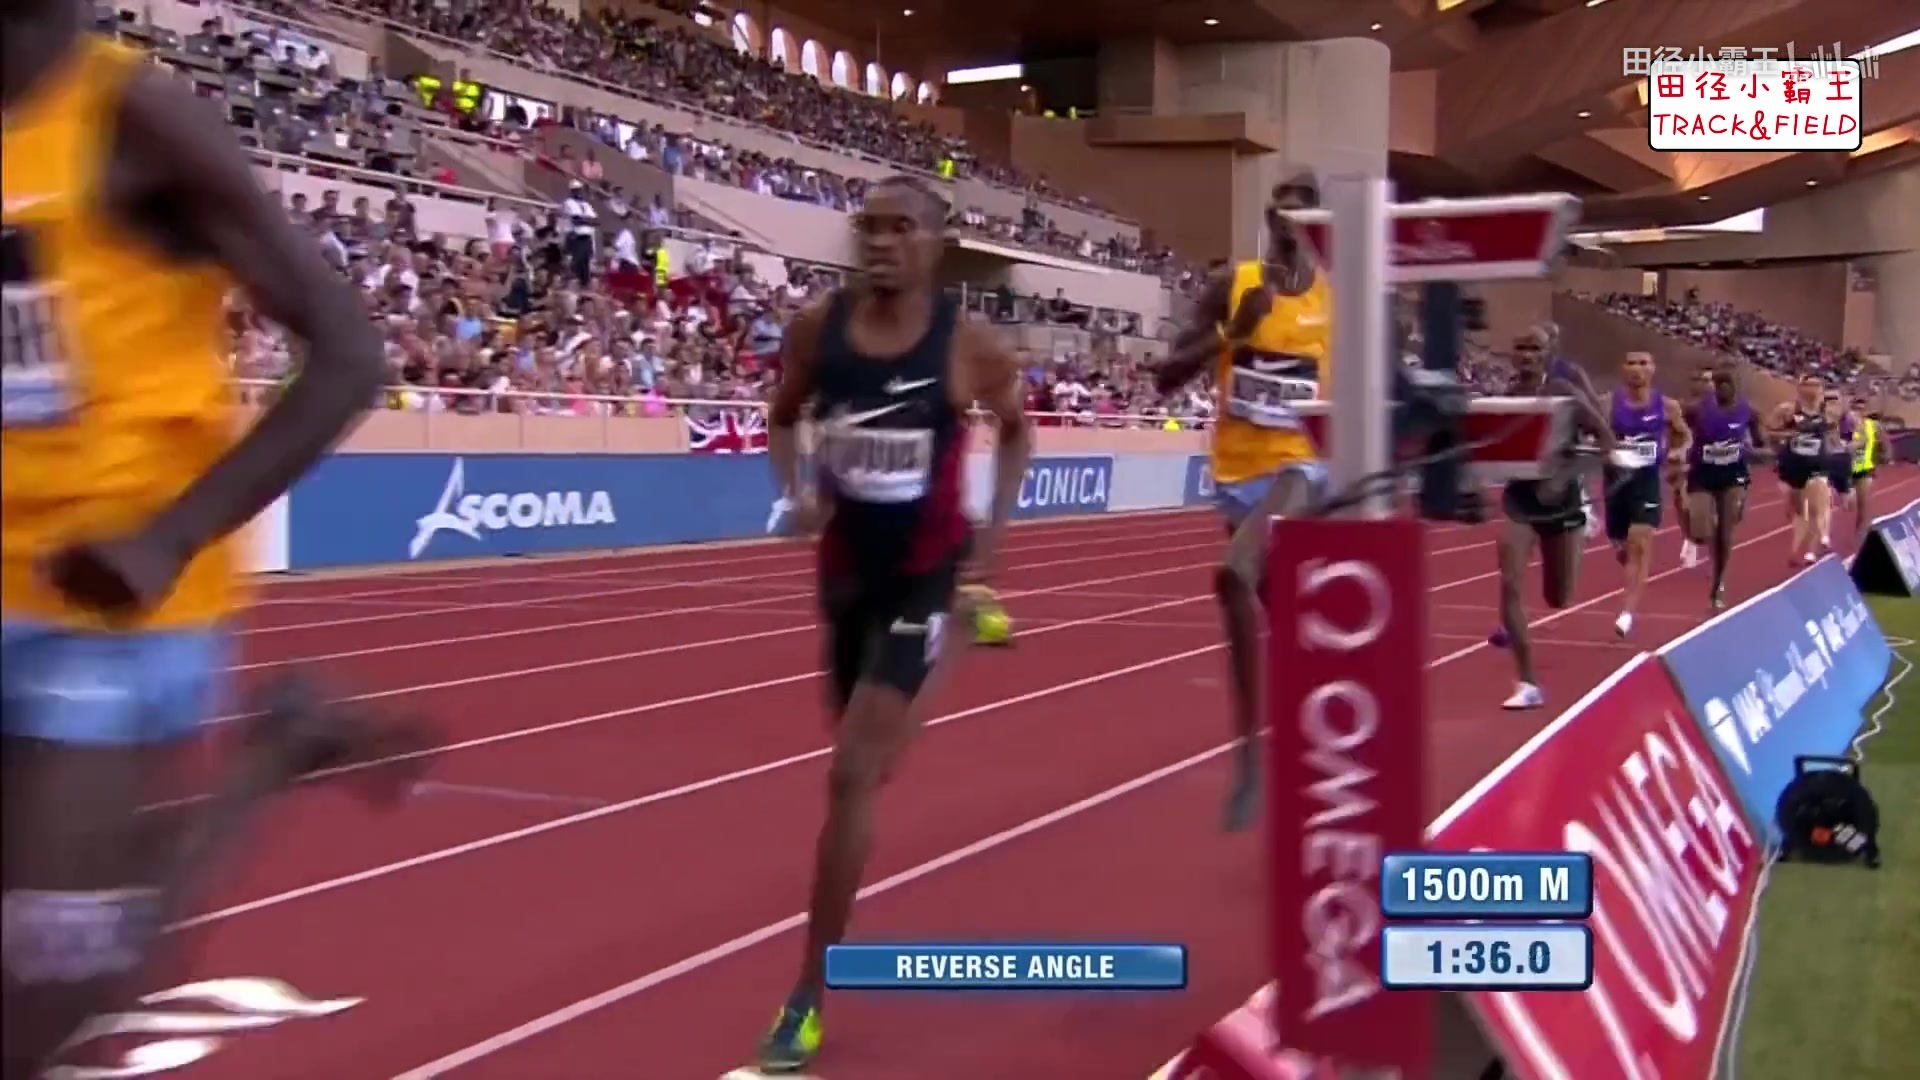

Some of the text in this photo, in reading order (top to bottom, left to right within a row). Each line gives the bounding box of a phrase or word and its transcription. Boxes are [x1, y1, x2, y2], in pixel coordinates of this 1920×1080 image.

[409, 456, 616, 560] ASCOMA
[1017, 466, 1105, 508] CONICA
[1301, 680, 1382, 1020] OMEGA
[1564, 708, 1752, 1043] OMEGA
